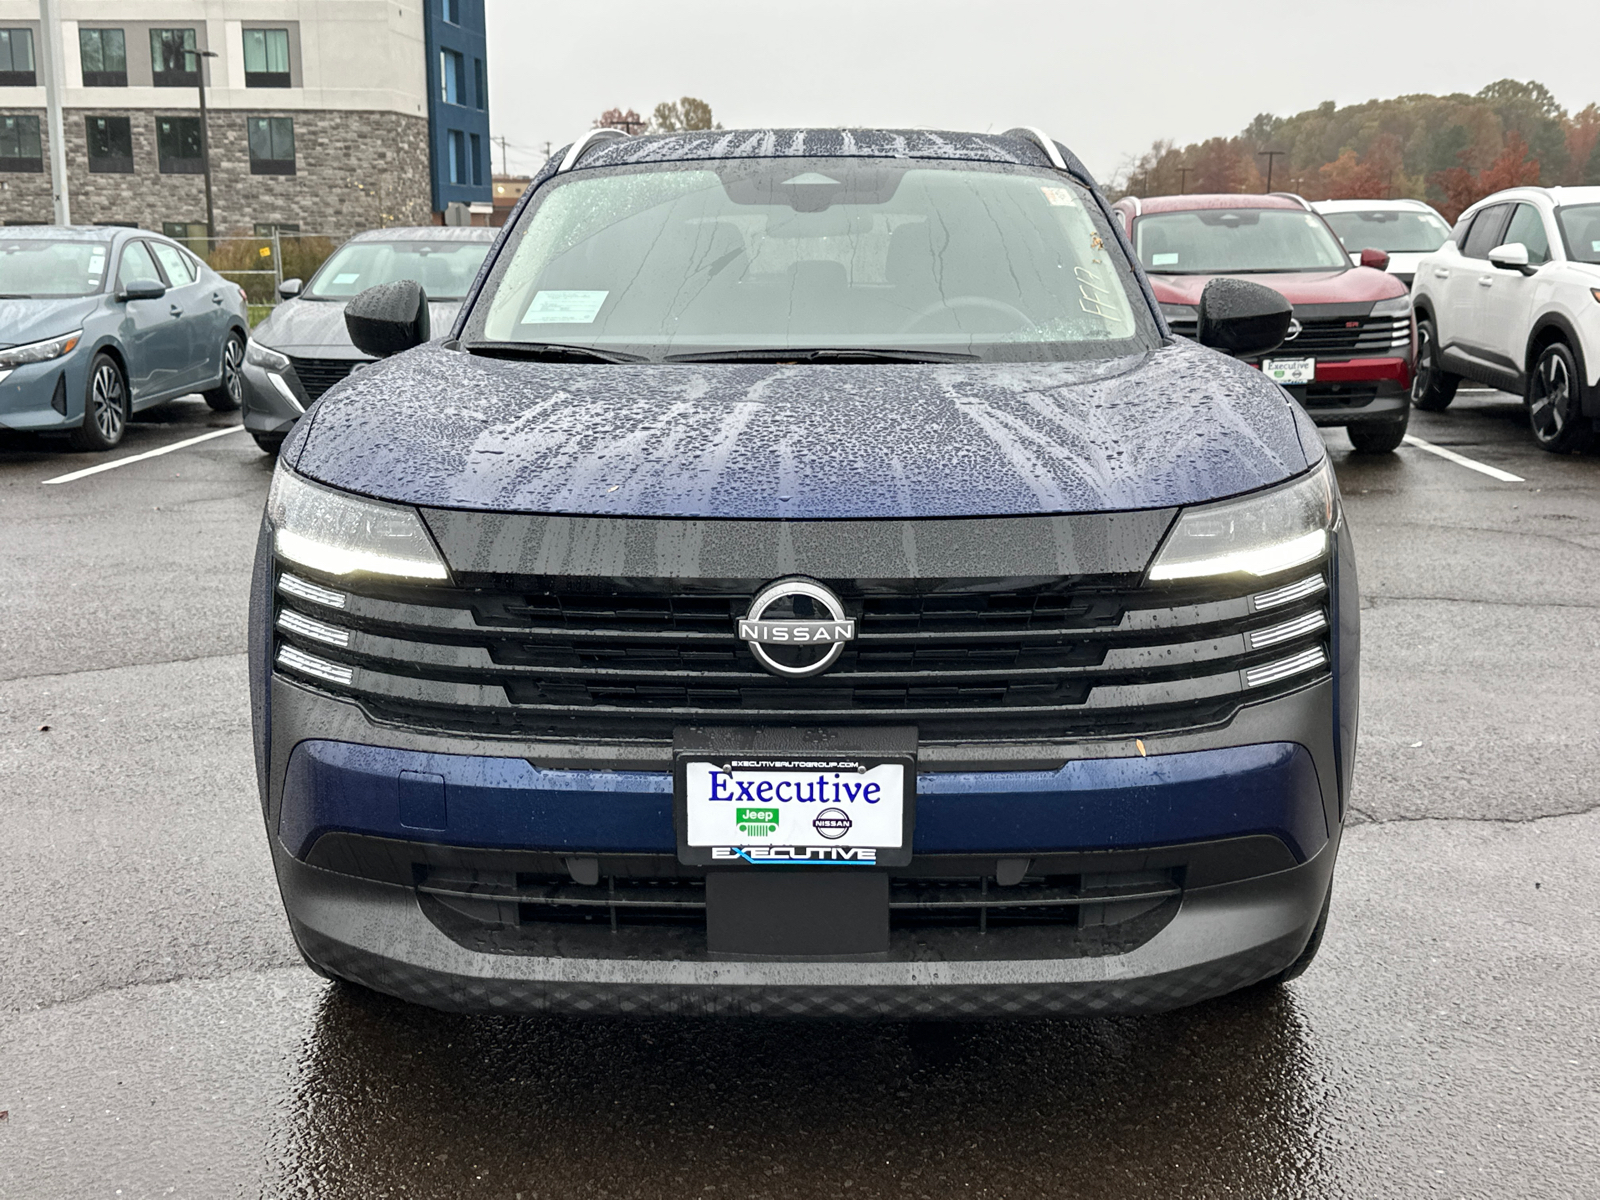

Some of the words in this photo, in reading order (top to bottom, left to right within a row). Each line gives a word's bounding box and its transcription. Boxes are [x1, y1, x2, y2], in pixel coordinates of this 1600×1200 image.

[1268, 362, 1309, 370] Executive
[741, 624, 851, 641] NISSAN
[731, 760, 859, 768] EXECUTIVEAUTOGROUP.COM
[708, 770, 881, 804] Executive
[742, 809, 774, 822] Jeep
[711, 847, 877, 861] EXECUTIVE
